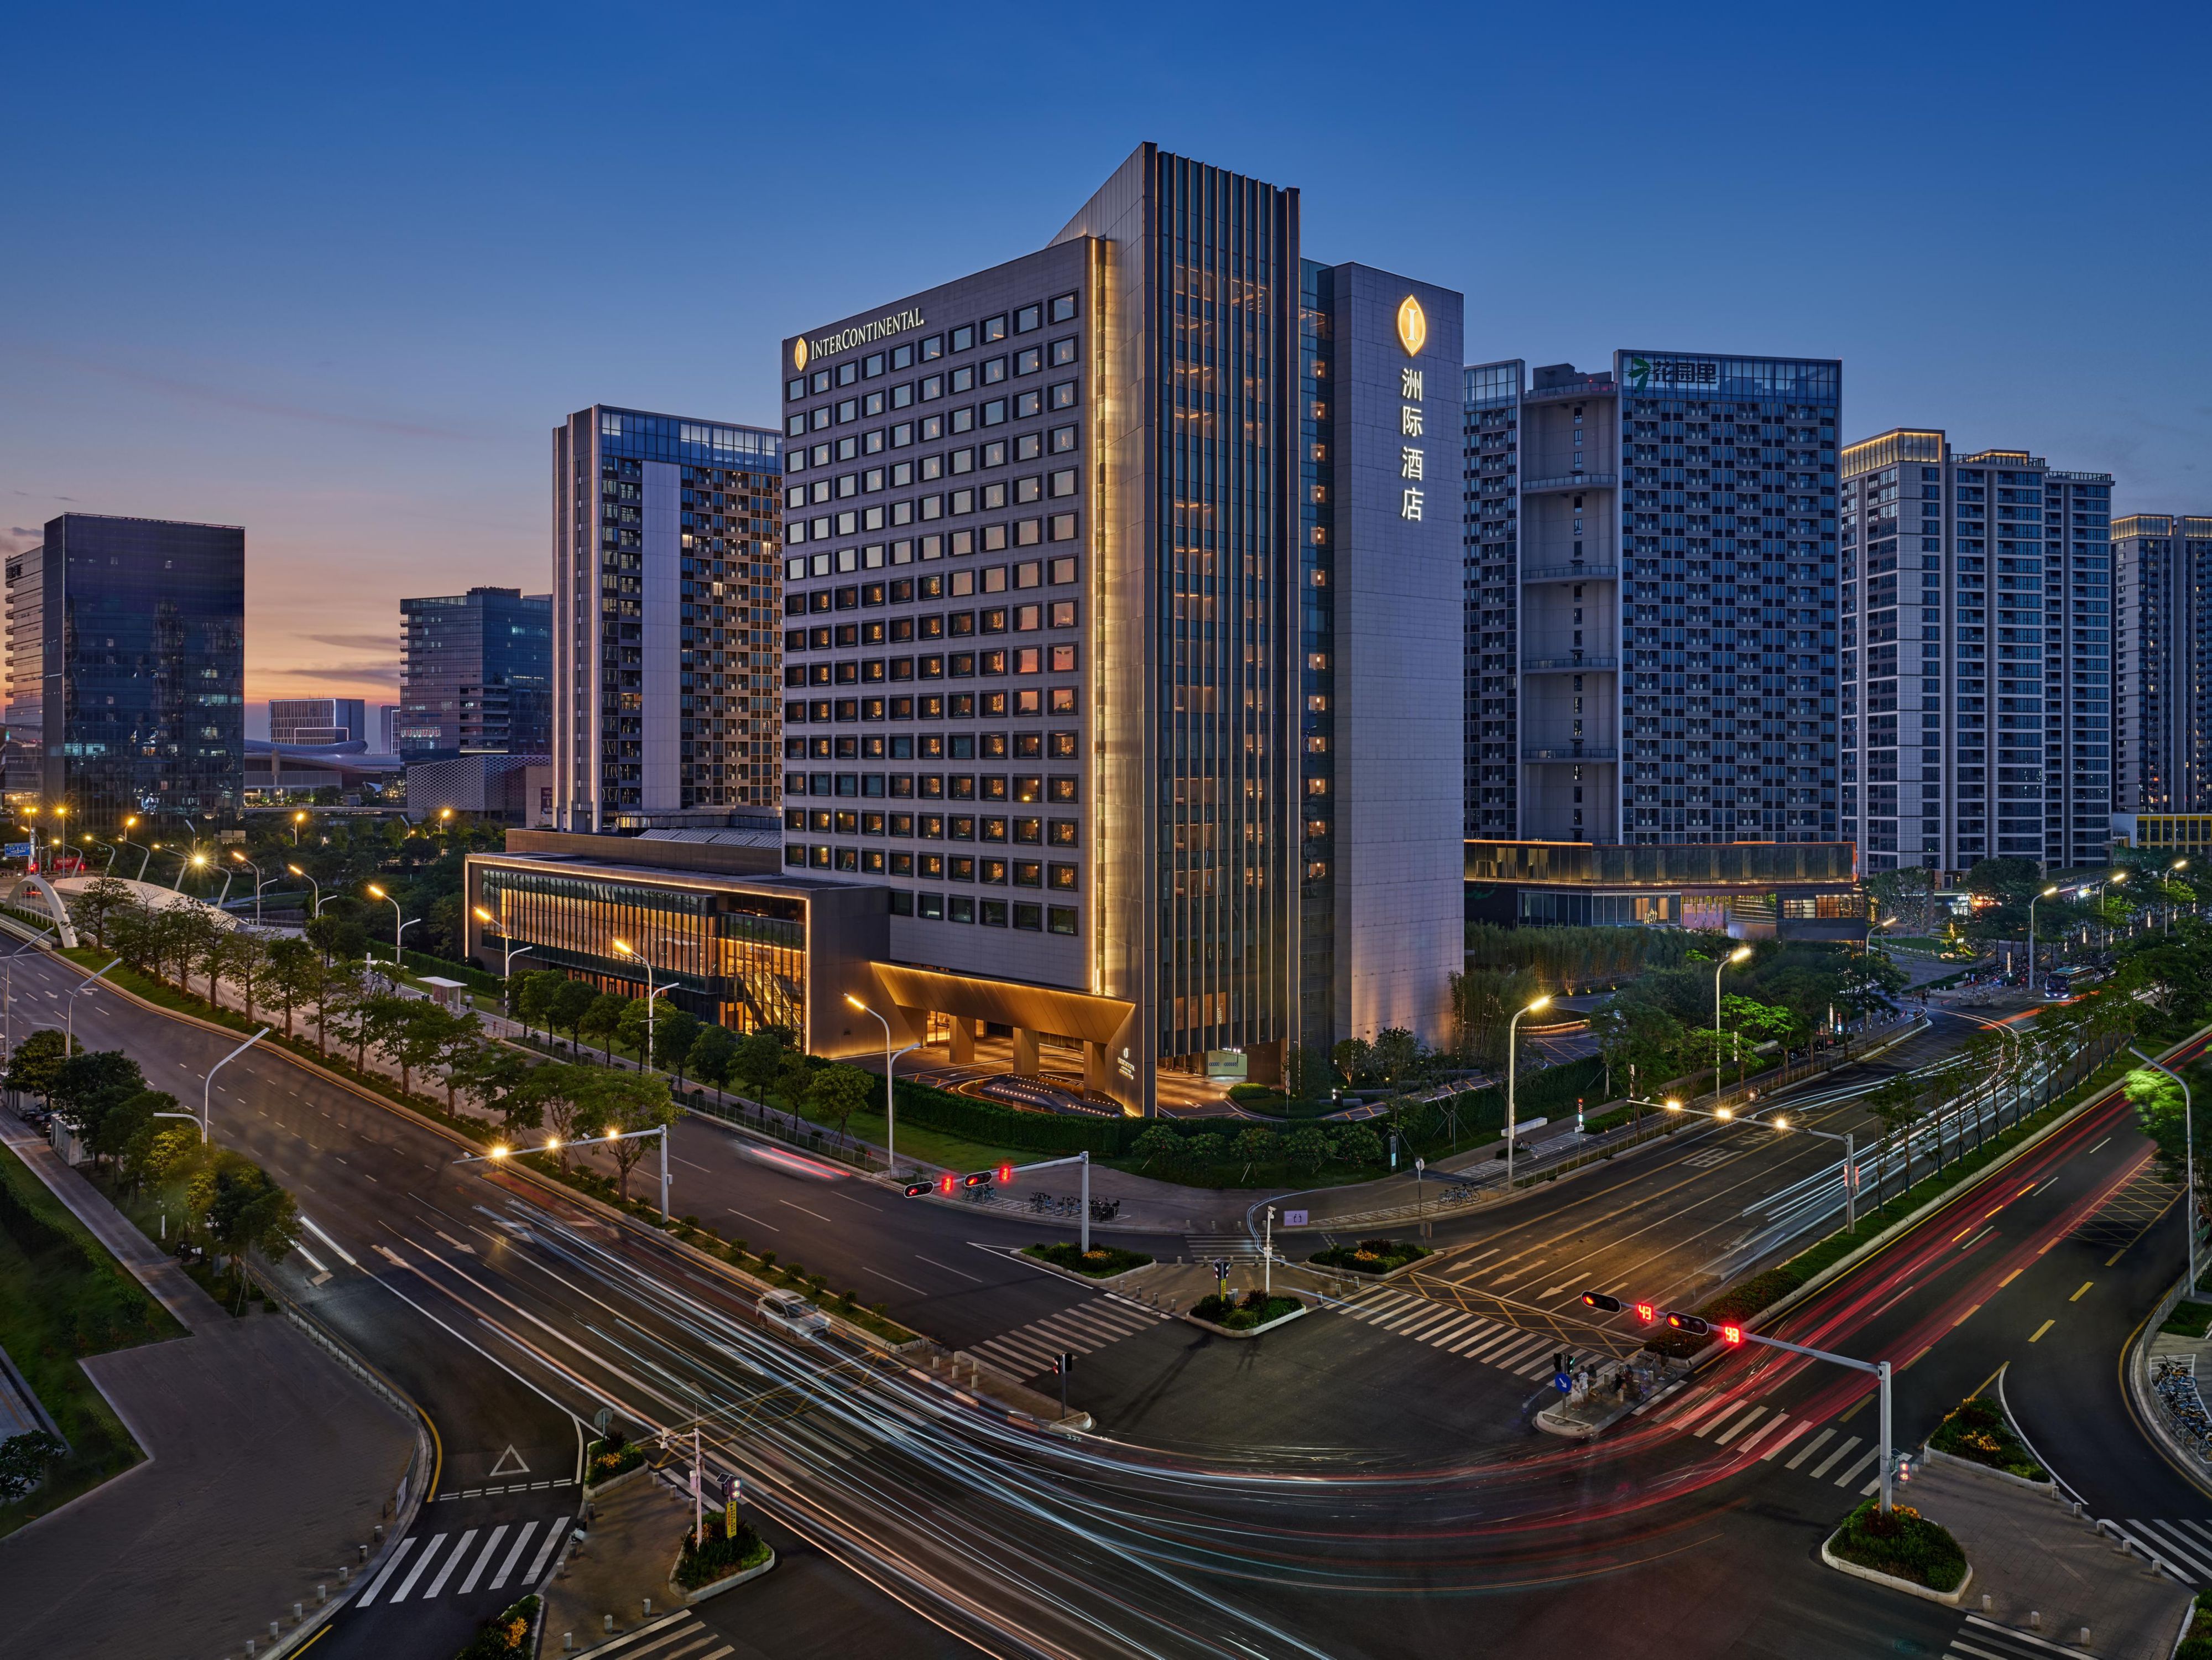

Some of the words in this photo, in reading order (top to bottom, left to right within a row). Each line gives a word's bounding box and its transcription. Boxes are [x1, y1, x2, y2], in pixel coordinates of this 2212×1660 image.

[1653, 361, 1717, 383] 花园里
[1401, 367, 1424, 521] 洲际酒店
[1638, 1304, 1652, 1321] 43
